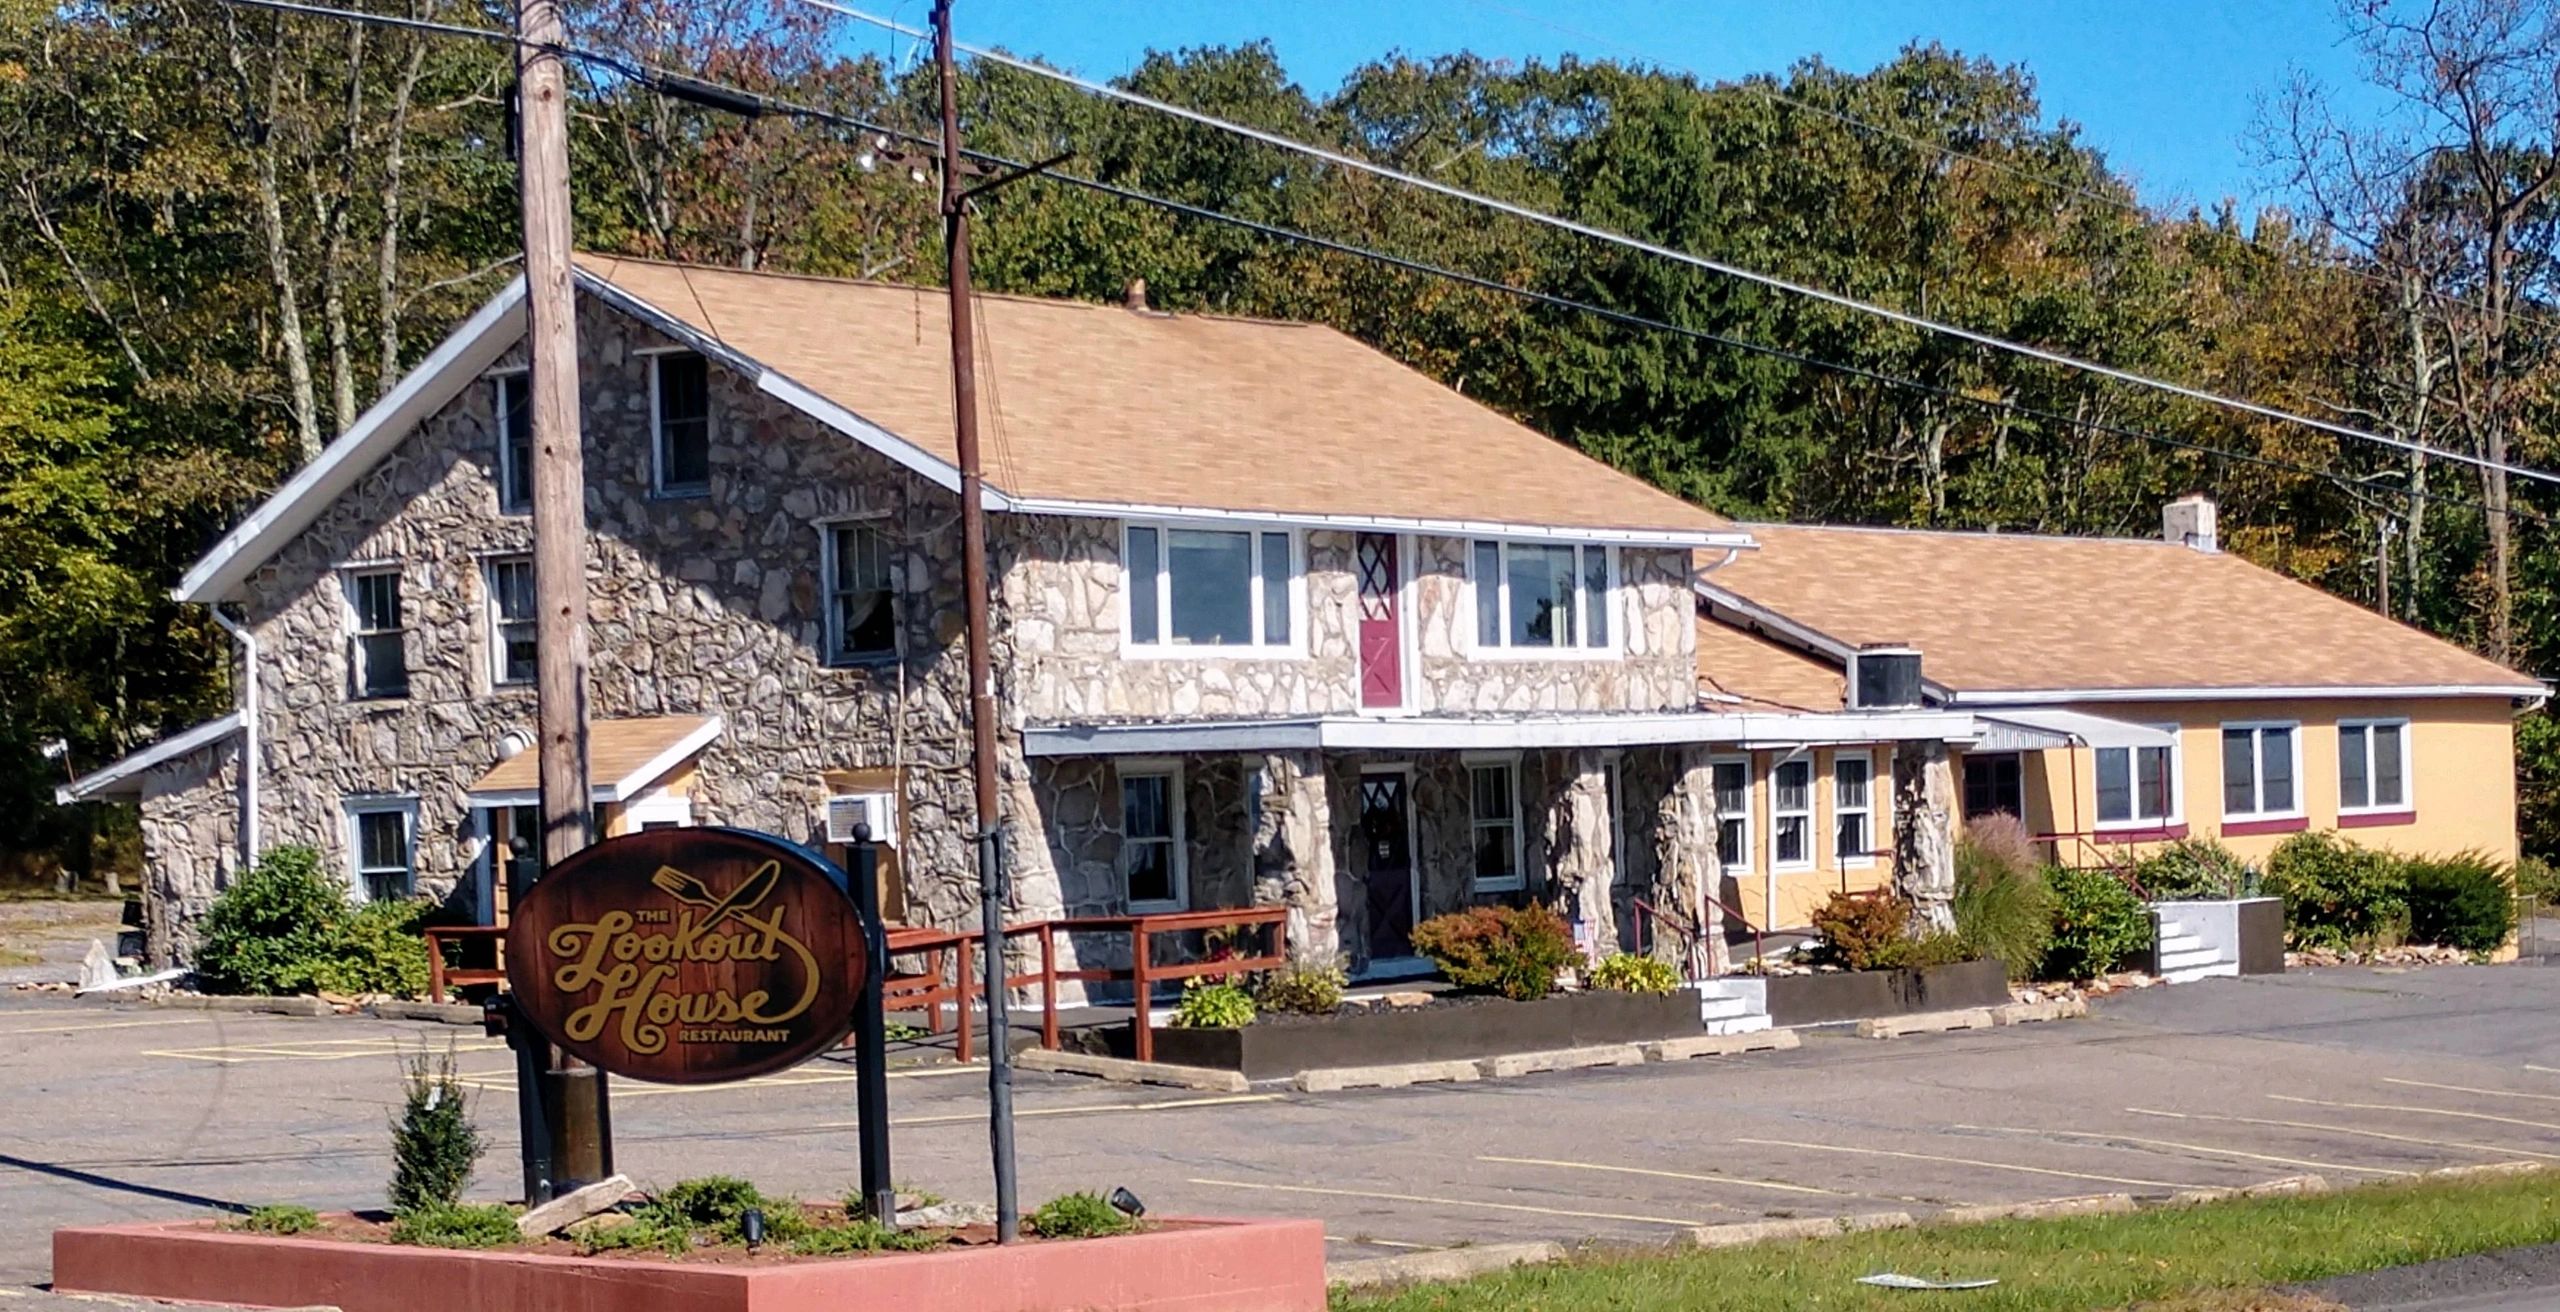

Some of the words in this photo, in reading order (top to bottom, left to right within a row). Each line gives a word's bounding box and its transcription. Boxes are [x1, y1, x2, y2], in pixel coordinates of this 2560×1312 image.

[636, 909, 671, 923] THE
[549, 904, 786, 992] Lookout
[564, 963, 772, 1054] House
[678, 1028, 791, 1043] RESTAURANT
